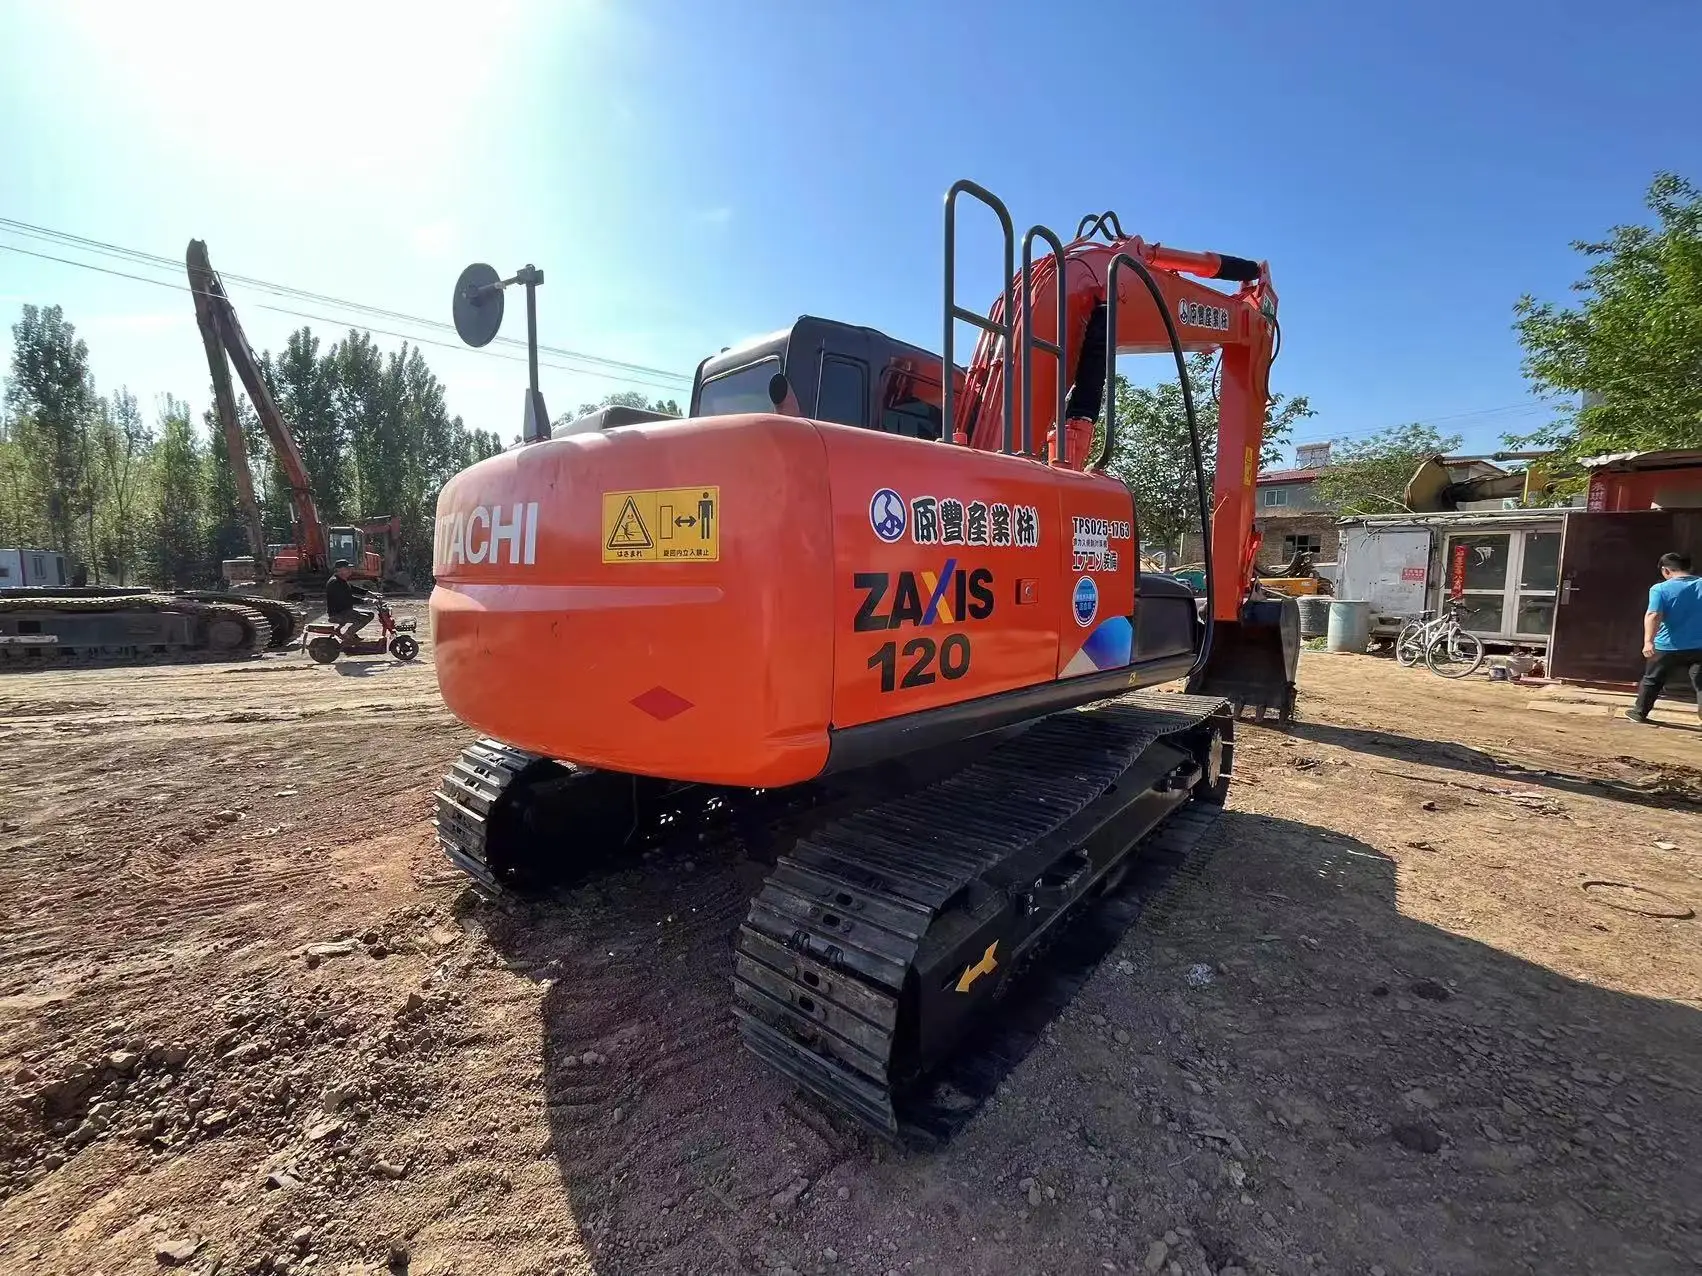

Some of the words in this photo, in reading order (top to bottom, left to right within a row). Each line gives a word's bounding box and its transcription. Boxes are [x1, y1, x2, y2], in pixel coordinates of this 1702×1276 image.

[1072, 517, 1130, 539] TPS025-1763
[853, 558, 995, 632] ZAXIS
[867, 633, 971, 693] 120
